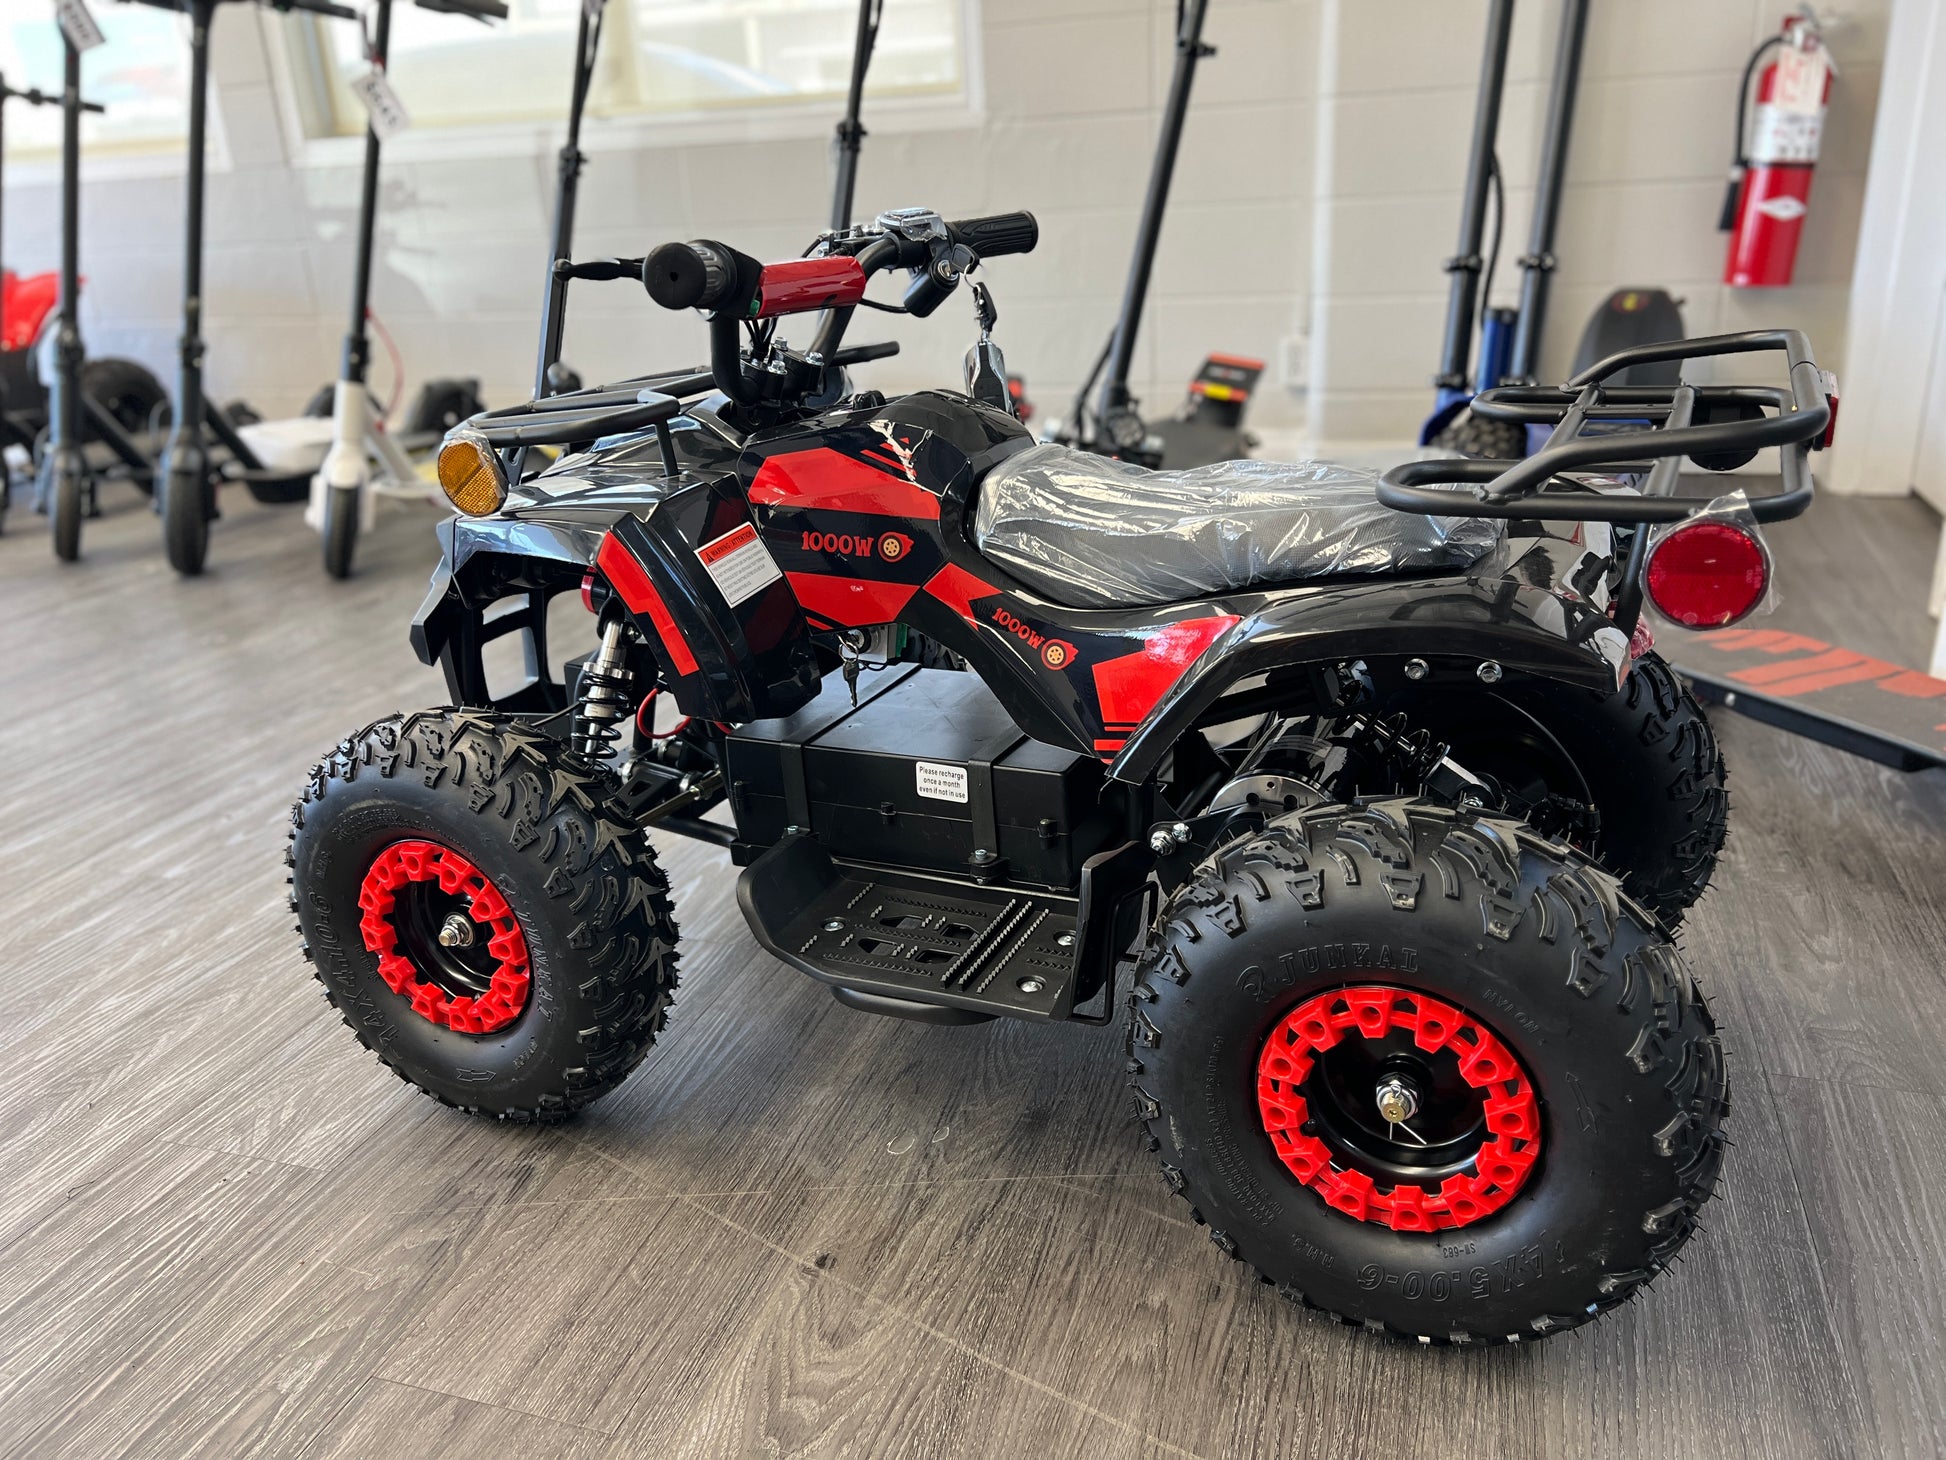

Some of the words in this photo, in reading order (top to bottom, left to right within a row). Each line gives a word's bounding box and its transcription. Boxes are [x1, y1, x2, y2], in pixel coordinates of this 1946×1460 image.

[801, 531, 874, 557] 1000W
[992, 607, 1045, 650] 1000W
[919, 766, 938, 776] Please
[938, 770, 964, 781] recharge
[942, 780, 961, 789] month
[954, 791, 966, 799] use
